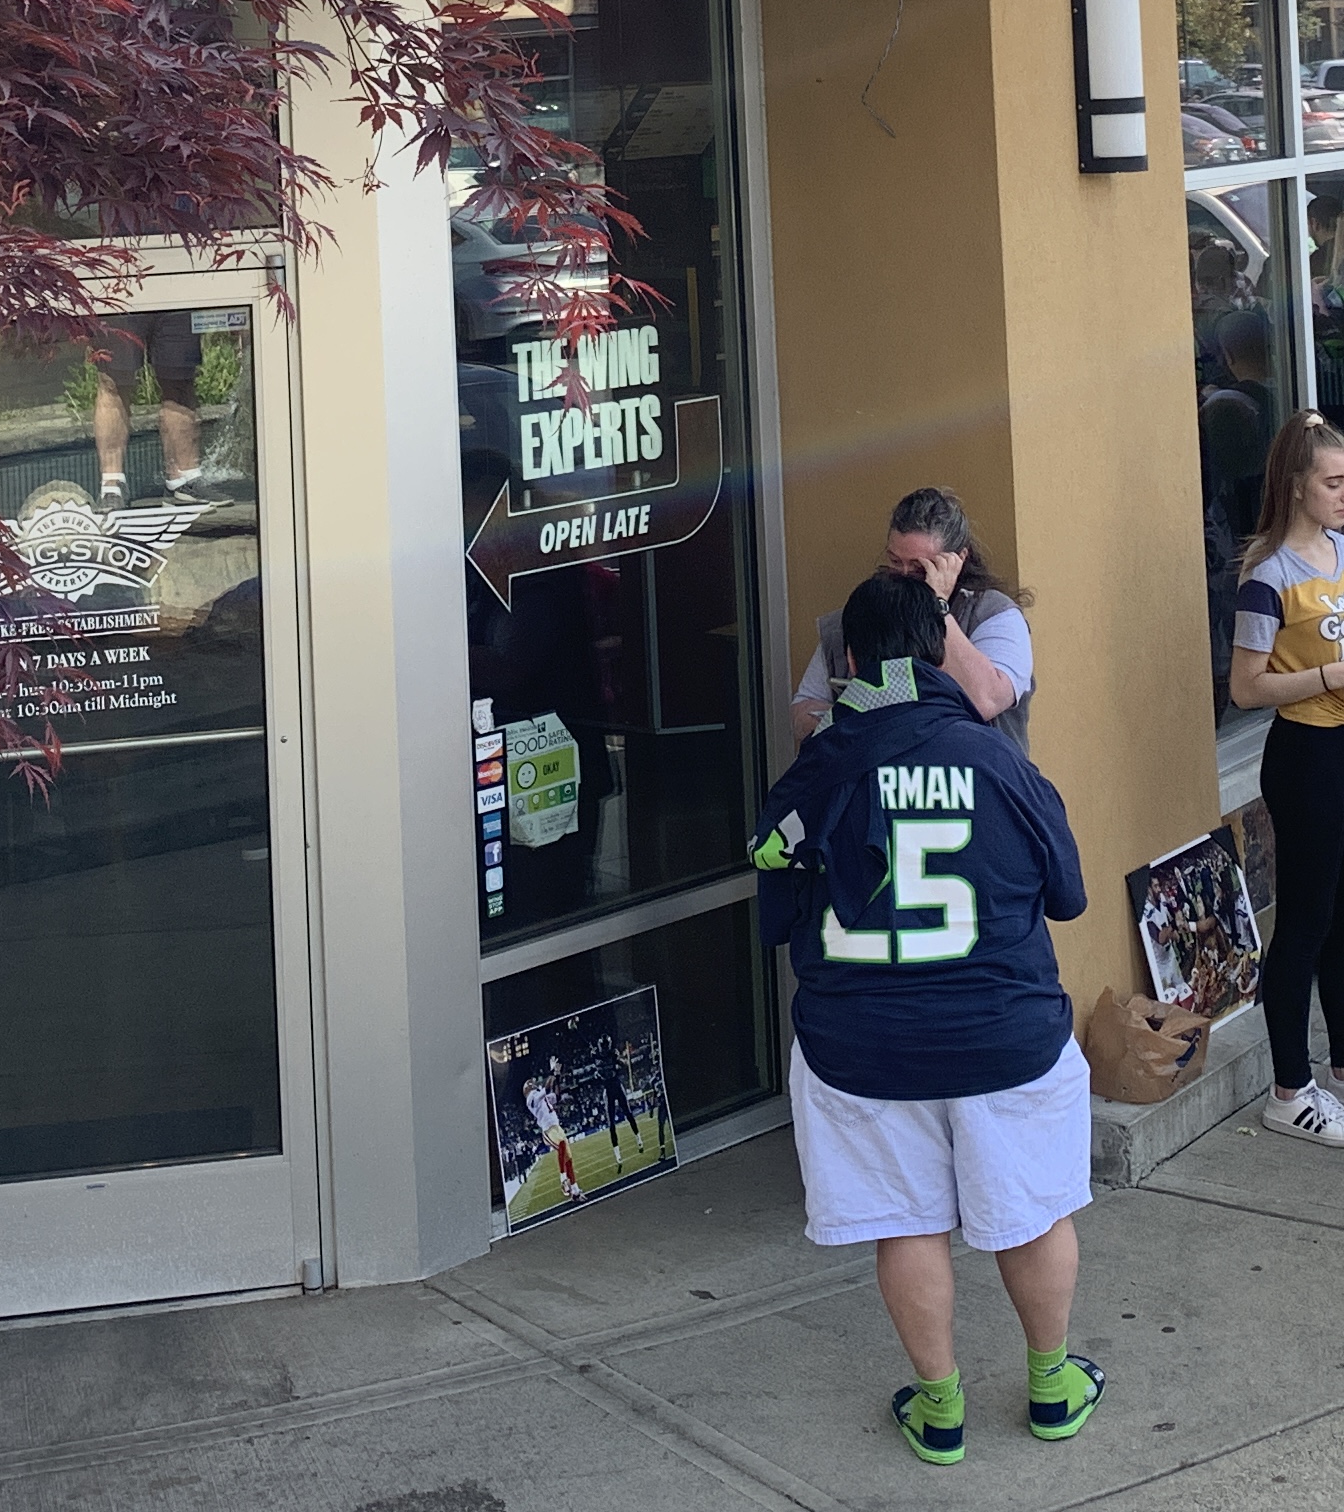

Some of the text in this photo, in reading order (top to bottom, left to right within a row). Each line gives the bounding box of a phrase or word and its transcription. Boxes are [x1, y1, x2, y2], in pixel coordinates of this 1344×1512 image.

[512, 325, 660, 403] THE WING
[520, 394, 663, 481] EXPERTS
[37, 515, 91, 534] THE WING
[540, 504, 651, 554] OPEN LATE
[40, 569, 89, 588] EXPERTS
[33, 655, 42, 671] 7
[47, 651, 86, 669] DAYS
[90, 649, 101, 665] A
[104, 645, 150, 664] WEEK
[84, 694, 106, 713] till
[109, 689, 177, 710] Midnight
[543, 761, 560, 776] OKAY
[480, 791, 503, 807] VISA
